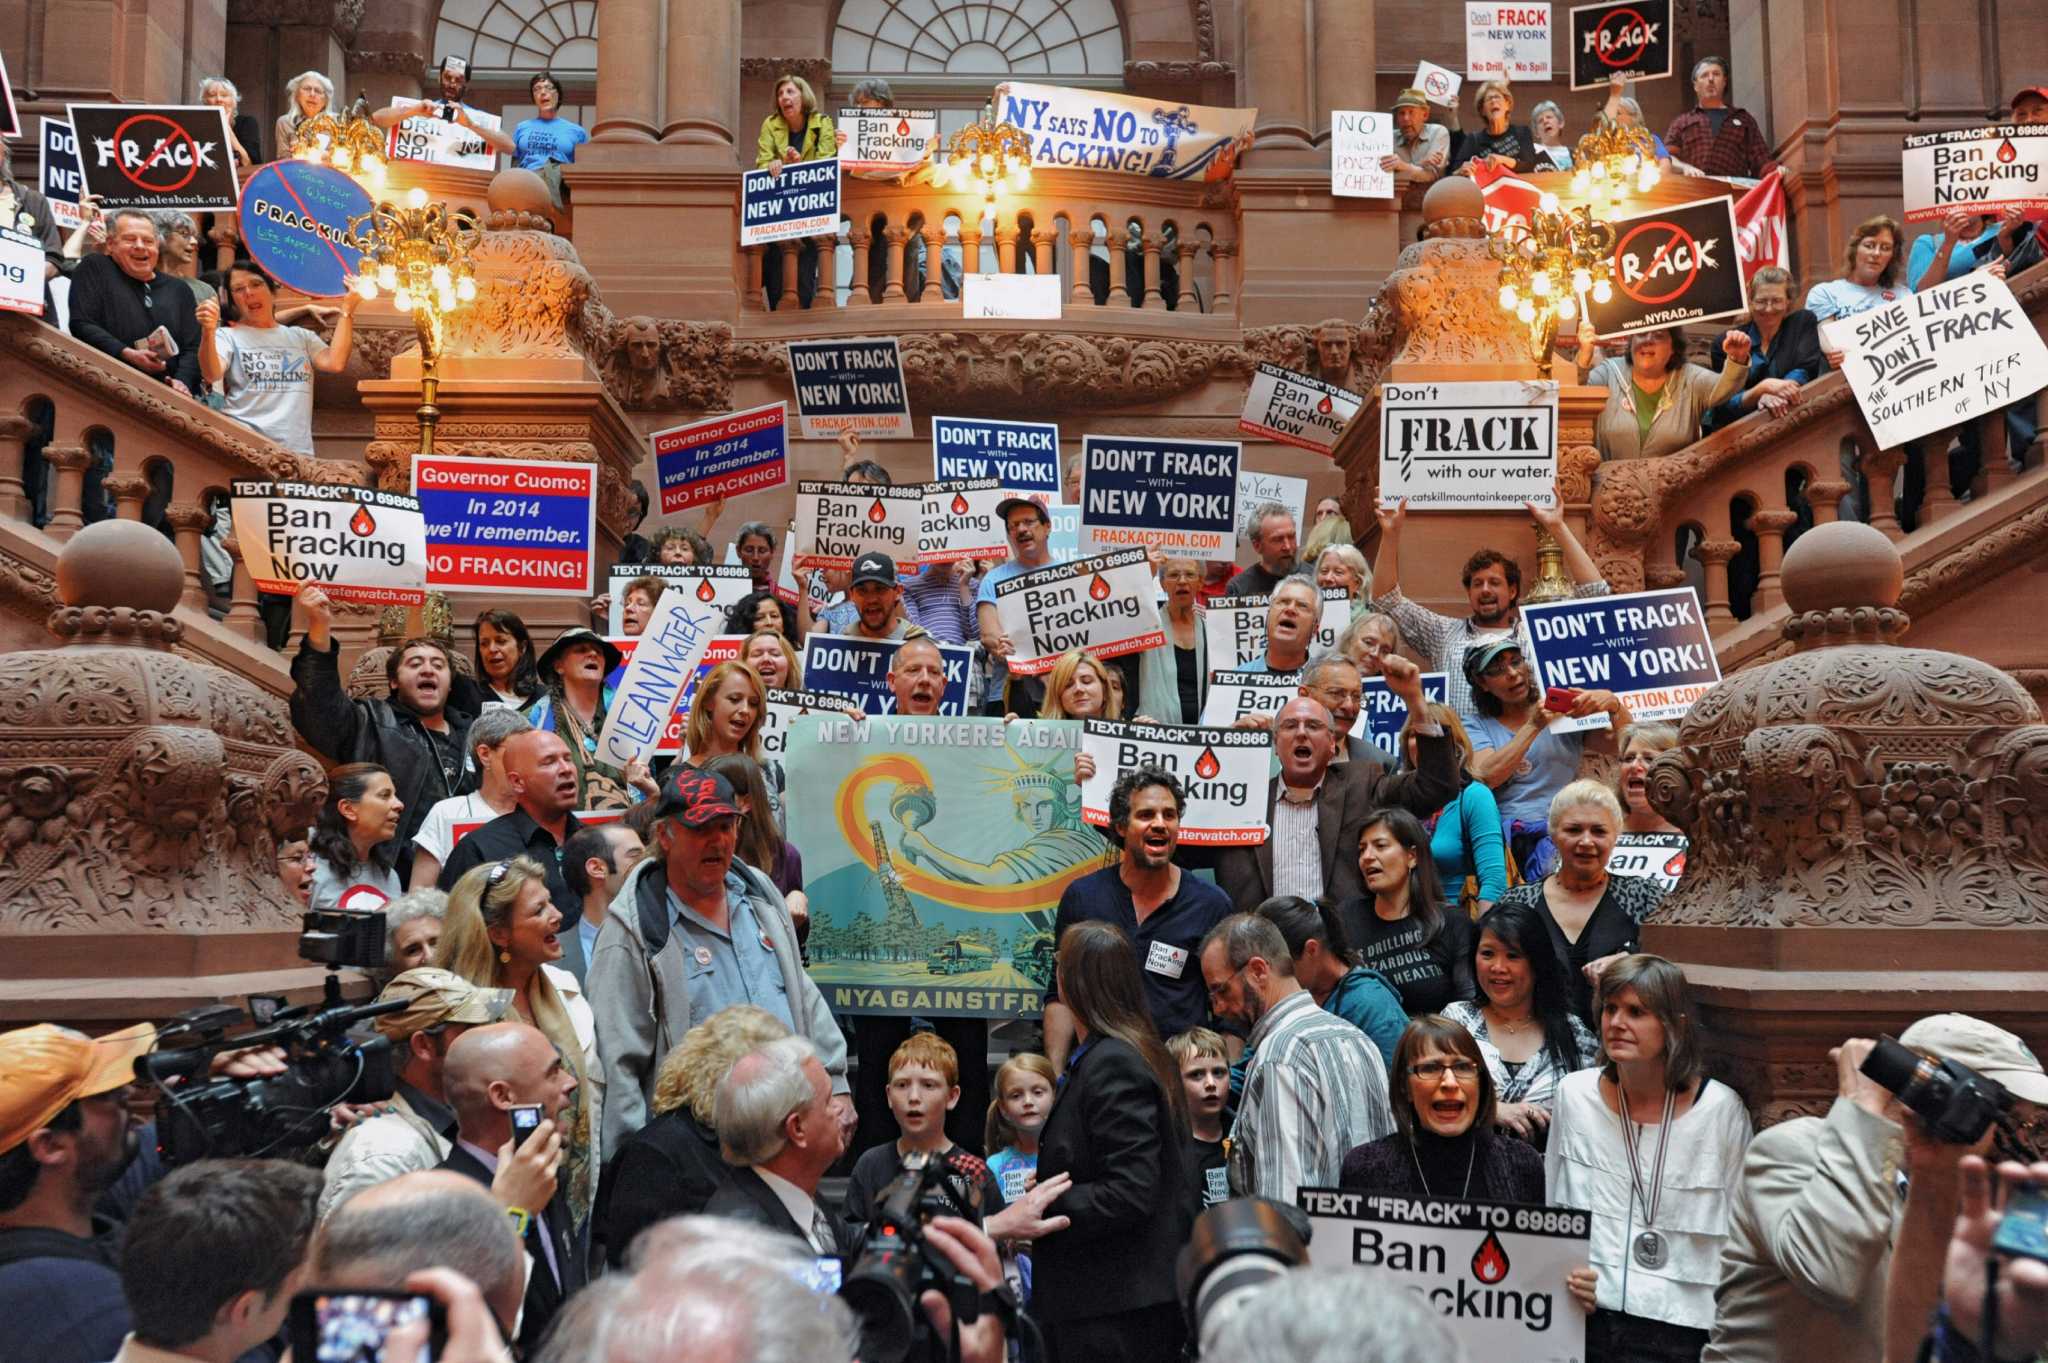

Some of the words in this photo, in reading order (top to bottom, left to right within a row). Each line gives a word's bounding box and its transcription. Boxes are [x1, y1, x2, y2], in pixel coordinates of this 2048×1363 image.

[1497, 9, 1547, 26] FRACK
[1488, 30, 1514, 40] NEW
[1516, 30, 1547, 40] YORK
[1583, 22, 1661, 54] FRACK
[1471, 62, 1484, 72] No
[1486, 62, 1503, 72] Drill
[1515, 62, 1527, 72] No
[1529, 62, 1548, 73] Spill
[840, 108, 861, 118] TEXT
[898, 110, 910, 119] TO
[1004, 95, 1050, 132] NY
[1048, 116, 1088, 137] SAYS
[1090, 107, 1137, 144] NO
[1140, 127, 1159, 145] TO
[1339, 114, 1376, 134] NO
[858, 119, 889, 134] Ban
[1904, 134, 1939, 148] TEXT
[1998, 126, 2015, 137] TO
[397, 132, 428, 147] NO
[857, 133, 925, 151] Fracking
[92, 134, 217, 170] FRACK
[857, 147, 893, 161] Now
[1001, 134, 1153, 173] ACKING!
[1934, 147, 1984, 166] Ban
[748, 173, 788, 194] DON'T
[791, 165, 836, 187] FRACK
[1934, 162, 2039, 185] Fracking
[747, 199, 783, 220] NEW
[787, 190, 836, 213] YORK!
[1934, 185, 1990, 205] Now
[749, 216, 832, 237] FRACKACTION.COM
[1622, 307, 1704, 330] www.NYRAD.org
[1855, 305, 1908, 346] SAVE
[1925, 307, 2014, 352] FRACK
[795, 349, 840, 371] DON'T
[844, 348, 895, 371] FRACK
[1261, 363, 1283, 378] TEXT
[1325, 384, 1338, 395] TO
[1871, 372, 1965, 426] SOUTHERN
[1974, 352, 2022, 382] TIER
[800, 384, 841, 407] NEW
[846, 383, 901, 406] YORK!
[1273, 381, 1309, 406] Ban
[1386, 385, 1439, 402] Don't
[1867, 385, 1889, 406] THE
[1954, 397, 1971, 415] OF
[1984, 376, 2011, 405] NY
[1263, 411, 1304, 436] Now
[1268, 396, 1345, 436] Fracking
[658, 425, 725, 452] Governor
[727, 412, 782, 435] Cuomo:
[940, 427, 993, 447] DON'T
[997, 430, 1053, 450] FRACK
[1400, 416, 1540, 453] FRACK
[695, 448, 709, 462] In
[713, 437, 749, 458] 2014
[987, 450, 1008, 458] WITH
[664, 463, 700, 485] we'll
[702, 447, 780, 475] remember.
[941, 457, 988, 478] NEW
[994, 460, 1054, 483] YORK!
[1091, 448, 1155, 474] DON'T
[1162, 452, 1233, 478] FRACK
[1427, 464, 1462, 479] with
[1468, 467, 1497, 479] our
[1502, 465, 1553, 479] water.
[421, 467, 509, 487] Governor
[514, 471, 587, 491] Cuomo:
[665, 490, 689, 508] NO
[694, 466, 783, 501] FRACKING!
[800, 483, 823, 494] TEXT
[872, 487, 888, 497] TO
[950, 481, 966, 491] TO
[1149, 478, 1174, 488] WITH
[1254, 476, 1283, 498] York
[233, 482, 273, 496] TEXT
[351, 488, 374, 502] TO
[1089, 488, 1147, 517] NEW
[1156, 491, 1230, 520] YORK!
[267, 503, 331, 530] Ban
[467, 498, 486, 515] In
[491, 500, 540, 518] 2014
[816, 497, 857, 519] Ban
[424, 521, 471, 539] we'll
[475, 525, 581, 544] remember.
[816, 517, 906, 546] Fracking
[1092, 528, 1222, 550] FRACKACTION.COM
[268, 529, 405, 567] Fracking
[815, 537, 861, 557] Now
[271, 556, 339, 582] Now
[460, 556, 583, 579] FRACKING!
[612, 565, 642, 577] TEXT
[698, 566, 714, 577] TO
[996, 577, 1028, 594] TEXT
[1085, 558, 1105, 572] TO
[1106, 550, 1146, 568] 69866
[1024, 587, 1077, 613] Ban
[1208, 596, 1238, 607] TEXT
[1028, 595, 1141, 635] Fracking
[1534, 611, 1605, 641] DON'T
[1614, 601, 1696, 632] FRACK
[1032, 630, 1090, 657] Now
[1605, 636, 1636, 650] WITH
[811, 647, 883, 675] DON'T
[1545, 653, 1611, 687] NEW
[1619, 643, 1708, 677] YORK!
[1216, 673, 1249, 685] TEXT
[797, 693, 816, 706] TO
[1238, 689, 1289, 711] Ban
[608, 667, 678, 761] CLEAN
[817, 720, 873, 745] NEW
[886, 721, 1006, 748] YORKERS
[1088, 719, 1127, 736] TEXT
[1198, 731, 1221, 744] TO
[1223, 731, 1269, 746] 69866
[1118, 743, 1178, 772] Ban
[1151, 943, 1169, 954] Ban
[1367, 928, 1423, 957] DRILLING
[1147, 959, 1167, 970] Now
[835, 987, 1046, 1012] NYAGAINSTFR
[1303, 1191, 1362, 1215] TEXT
[1477, 1204, 1510, 1228] TO
[1515, 1209, 1586, 1235] 69866
[1352, 1226, 1446, 1274] Ban
